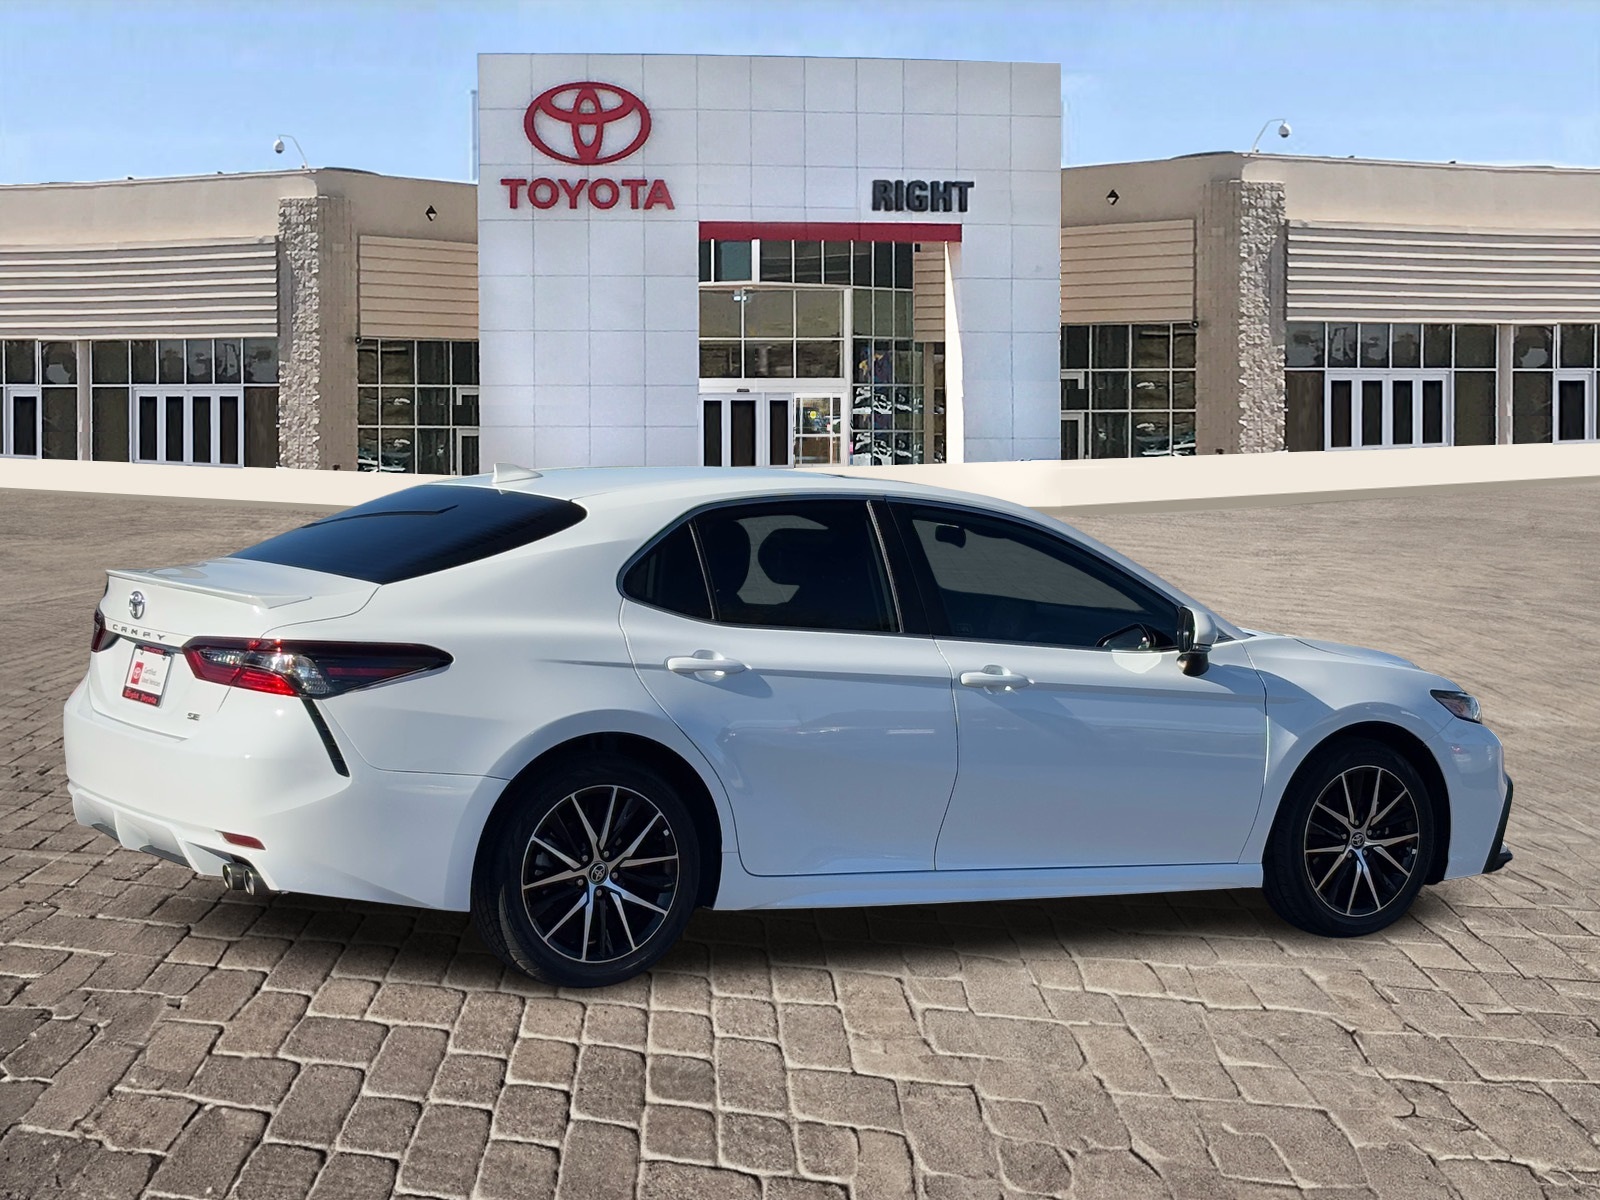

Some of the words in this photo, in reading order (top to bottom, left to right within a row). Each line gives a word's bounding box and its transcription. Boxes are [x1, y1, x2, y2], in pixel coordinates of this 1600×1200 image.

[500, 178, 675, 209] TOYOTA
[872, 180, 974, 212] RIGHT
[112, 624, 165, 640] CAMRY
[187, 712, 200, 721] SE
